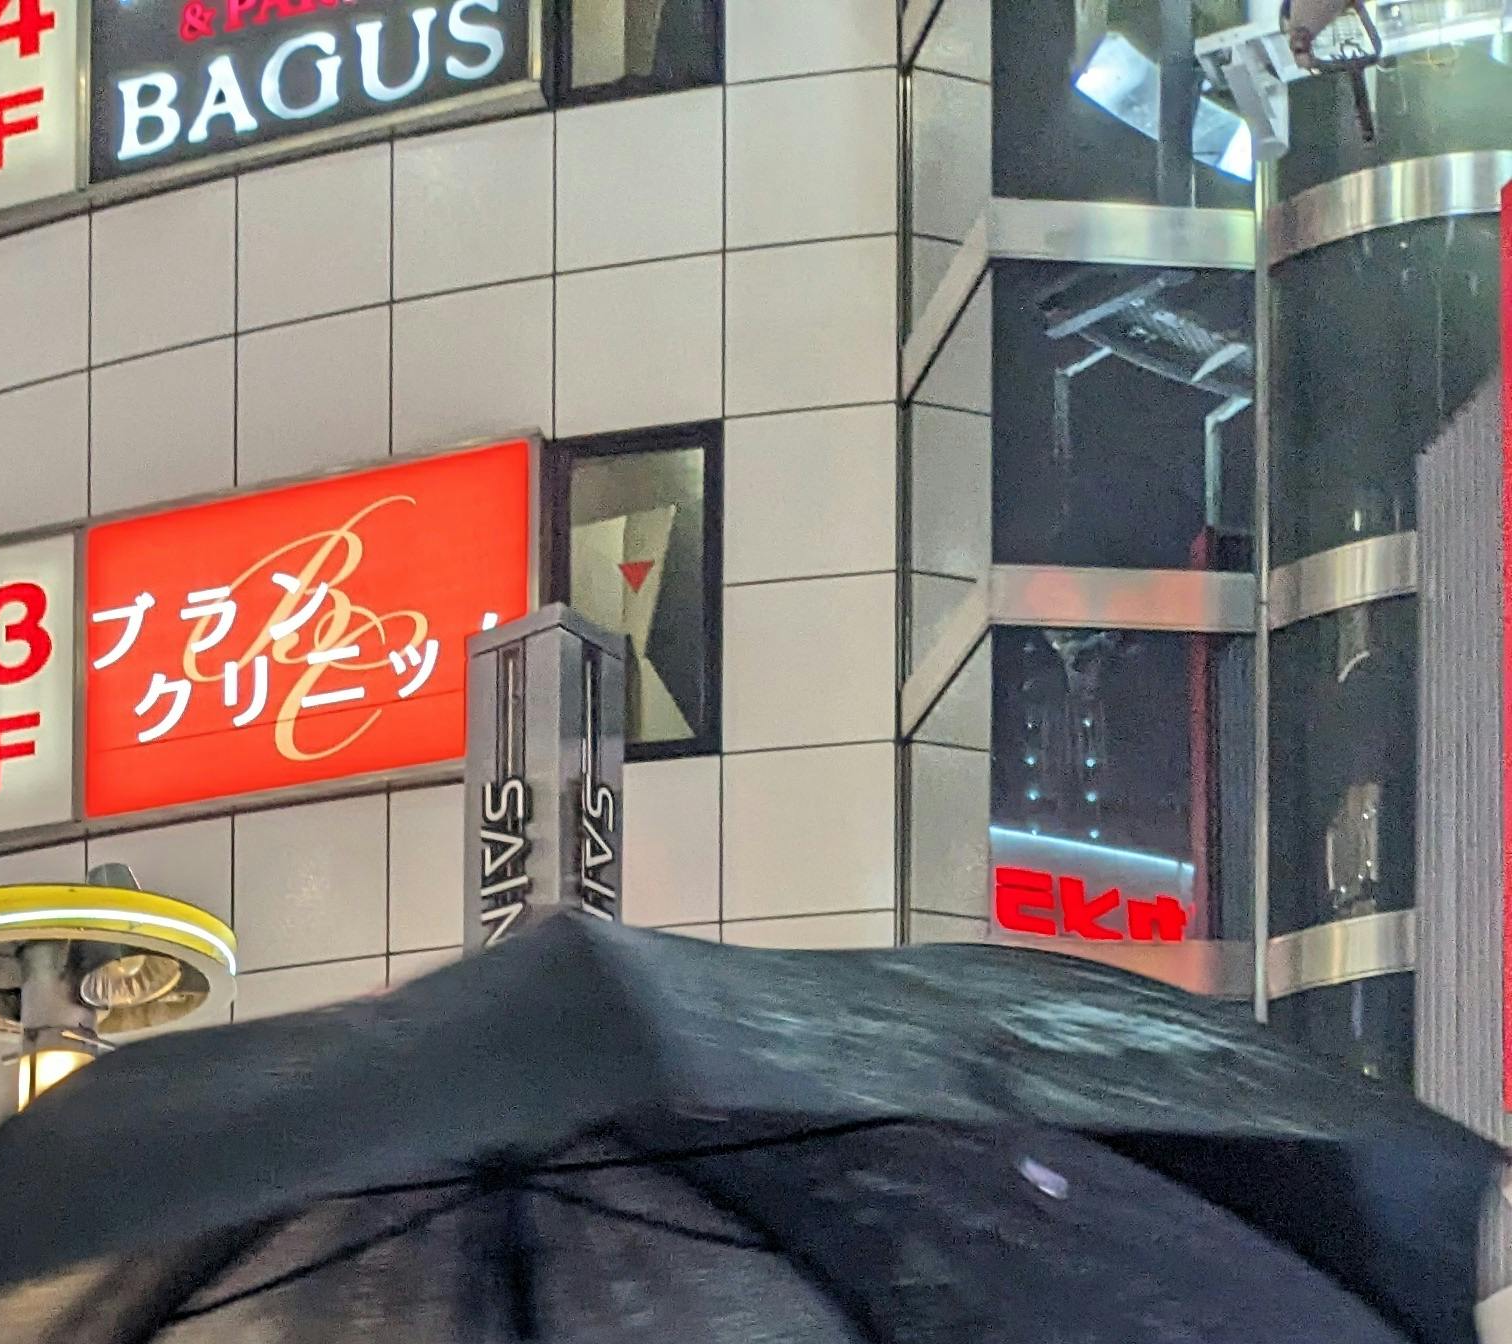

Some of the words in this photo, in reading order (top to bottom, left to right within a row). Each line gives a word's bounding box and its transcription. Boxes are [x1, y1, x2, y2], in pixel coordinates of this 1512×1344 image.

[116, 0, 505, 162] BAGUS
[91, 572, 329, 670] ブラン
[138, 612, 499, 743] クリニッ
